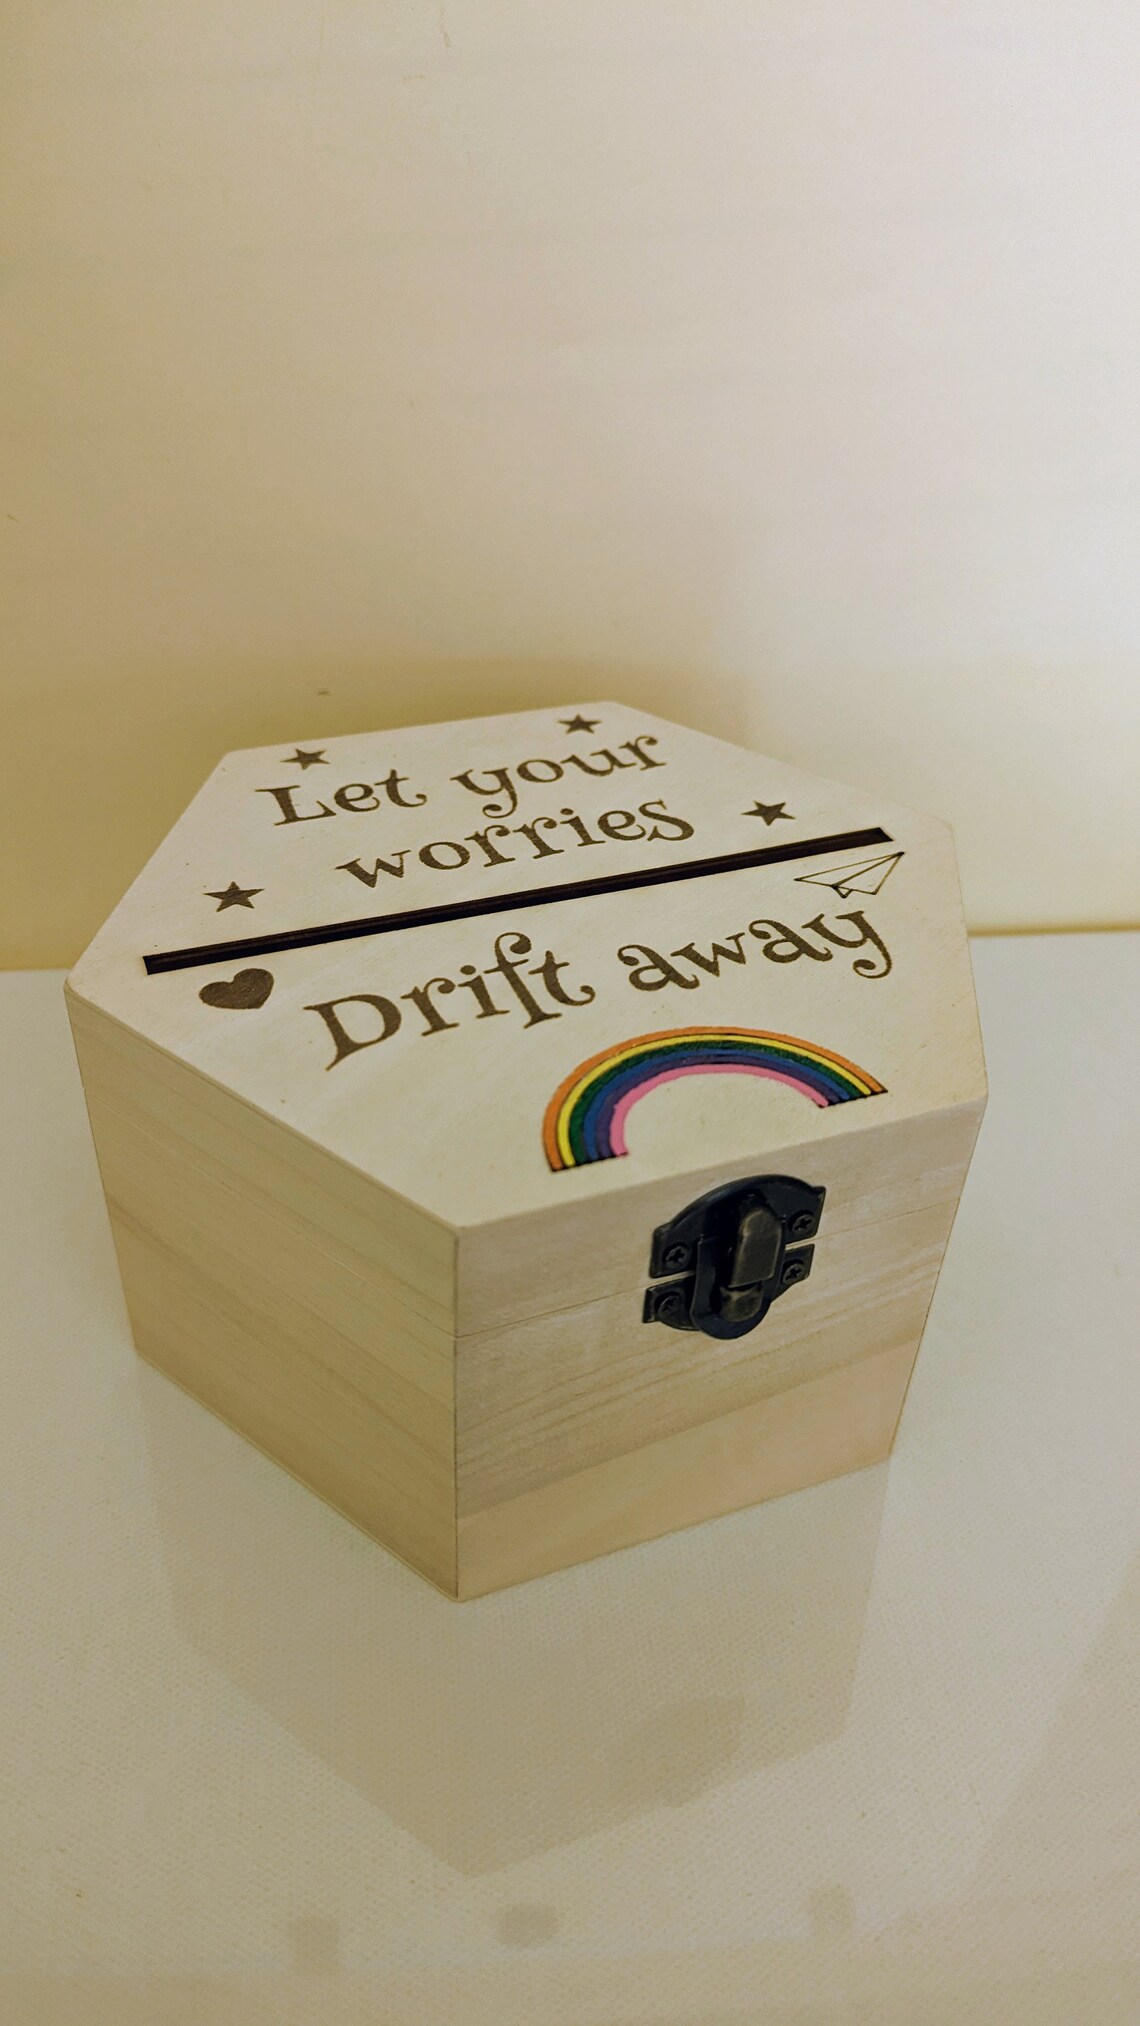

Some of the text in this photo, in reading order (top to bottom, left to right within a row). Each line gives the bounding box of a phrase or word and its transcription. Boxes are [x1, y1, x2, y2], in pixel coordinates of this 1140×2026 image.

[255, 734, 667, 826] Let your
[334, 799, 695, 889] worries
[302, 909, 894, 1073] Drift away
